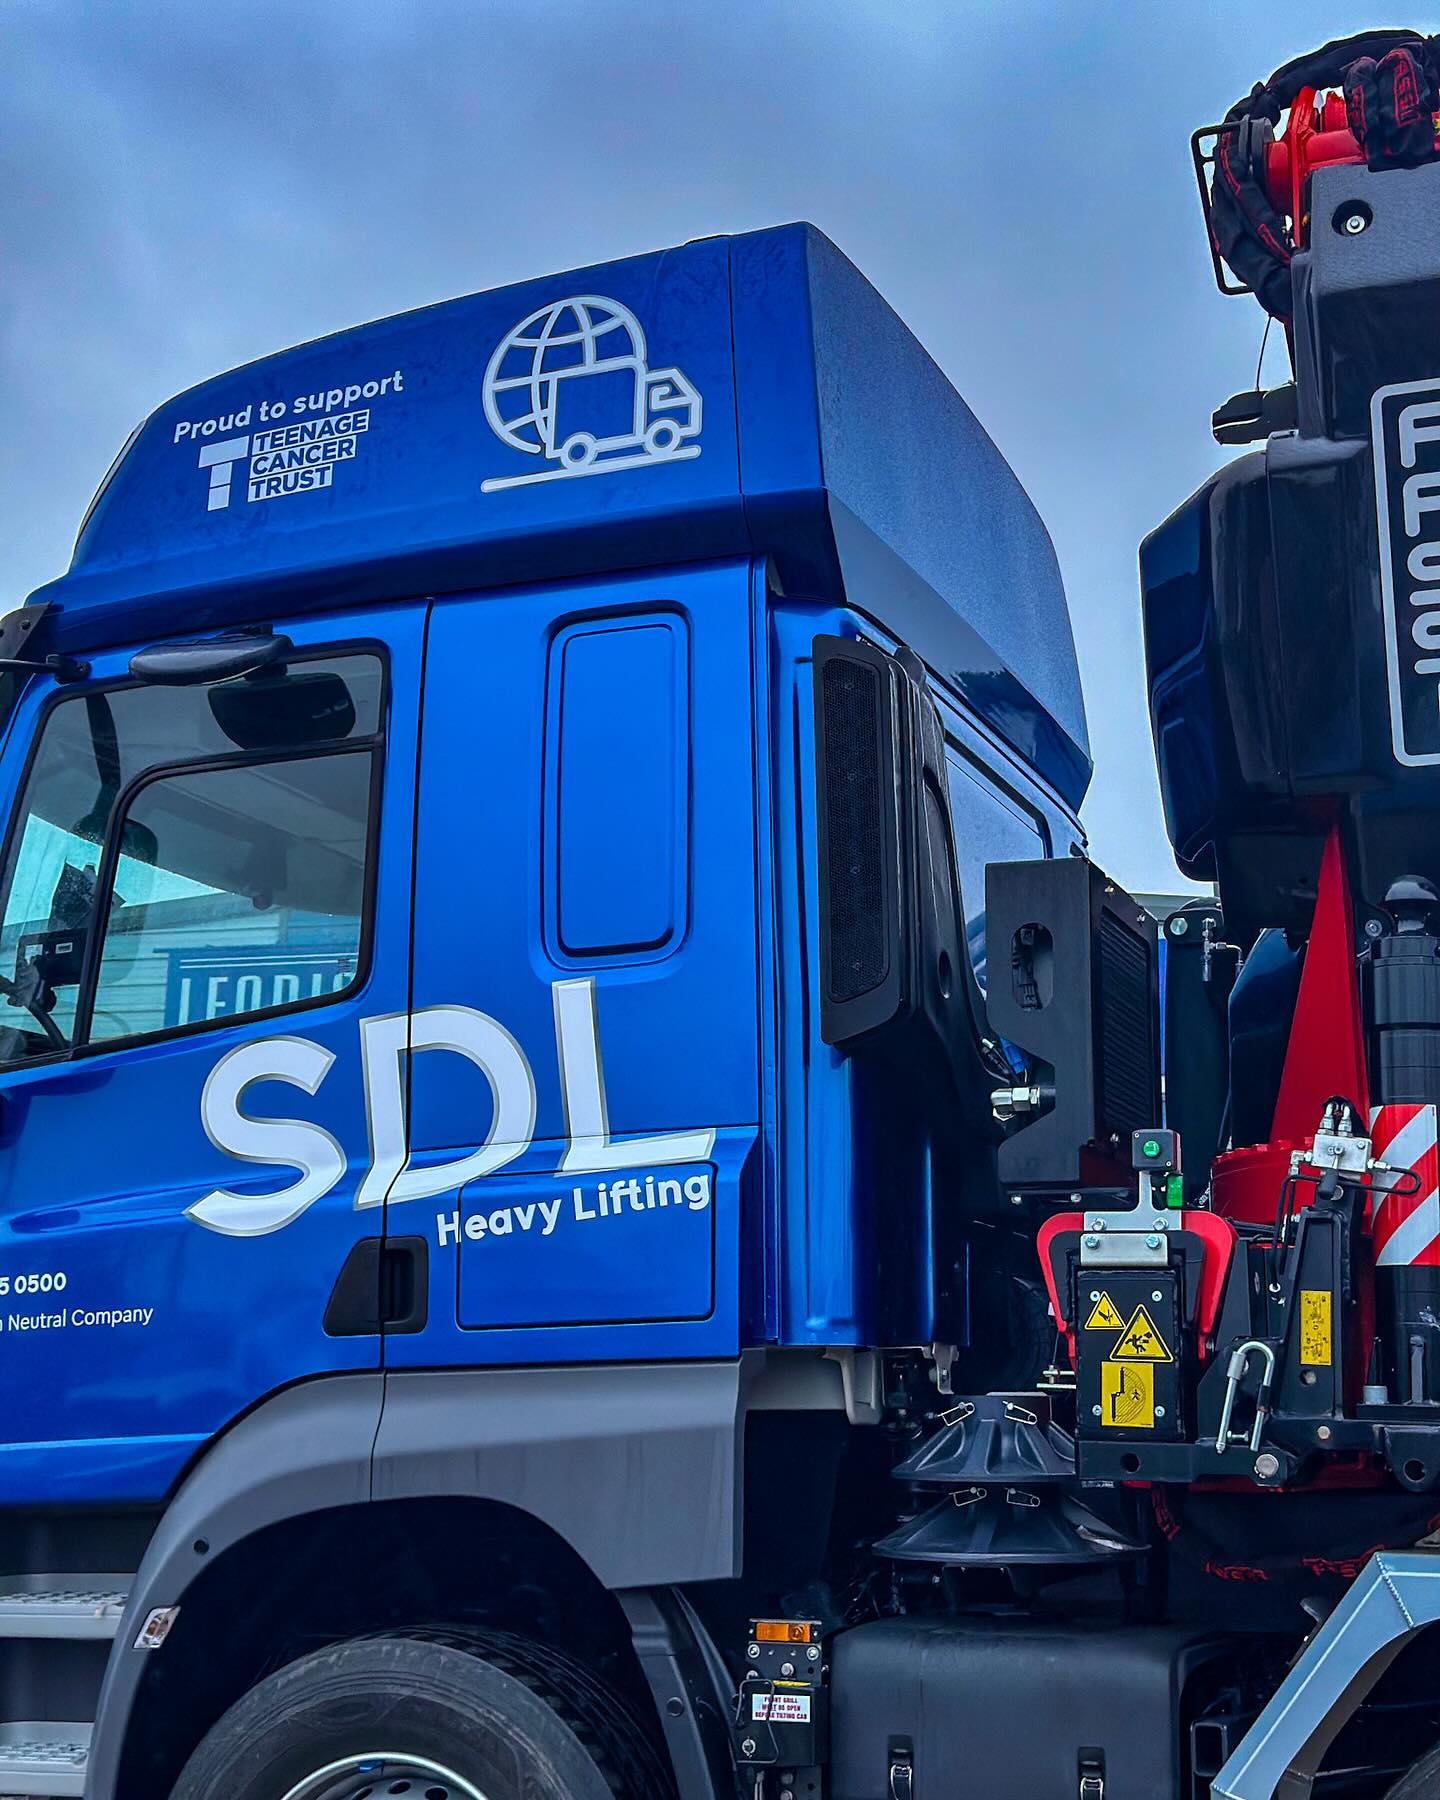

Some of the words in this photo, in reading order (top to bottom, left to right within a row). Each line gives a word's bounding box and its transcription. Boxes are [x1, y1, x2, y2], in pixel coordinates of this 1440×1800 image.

[173, 405, 251, 443] Proud
[259, 401, 286, 422] to
[293, 370, 404, 412] support
[254, 411, 369, 452] TEENAGE
[252, 438, 355, 475] CANCER
[250, 465, 331, 499] TRUST
[183, 976, 716, 1237] SDL
[436, 1198, 561, 1247] Heavy
[573, 1174, 710, 1221] Lifting
[14, 1272, 67, 1294] 0500
[8, 1309, 66, 1331] Neutral
[71, 1307, 154, 1328] Company
